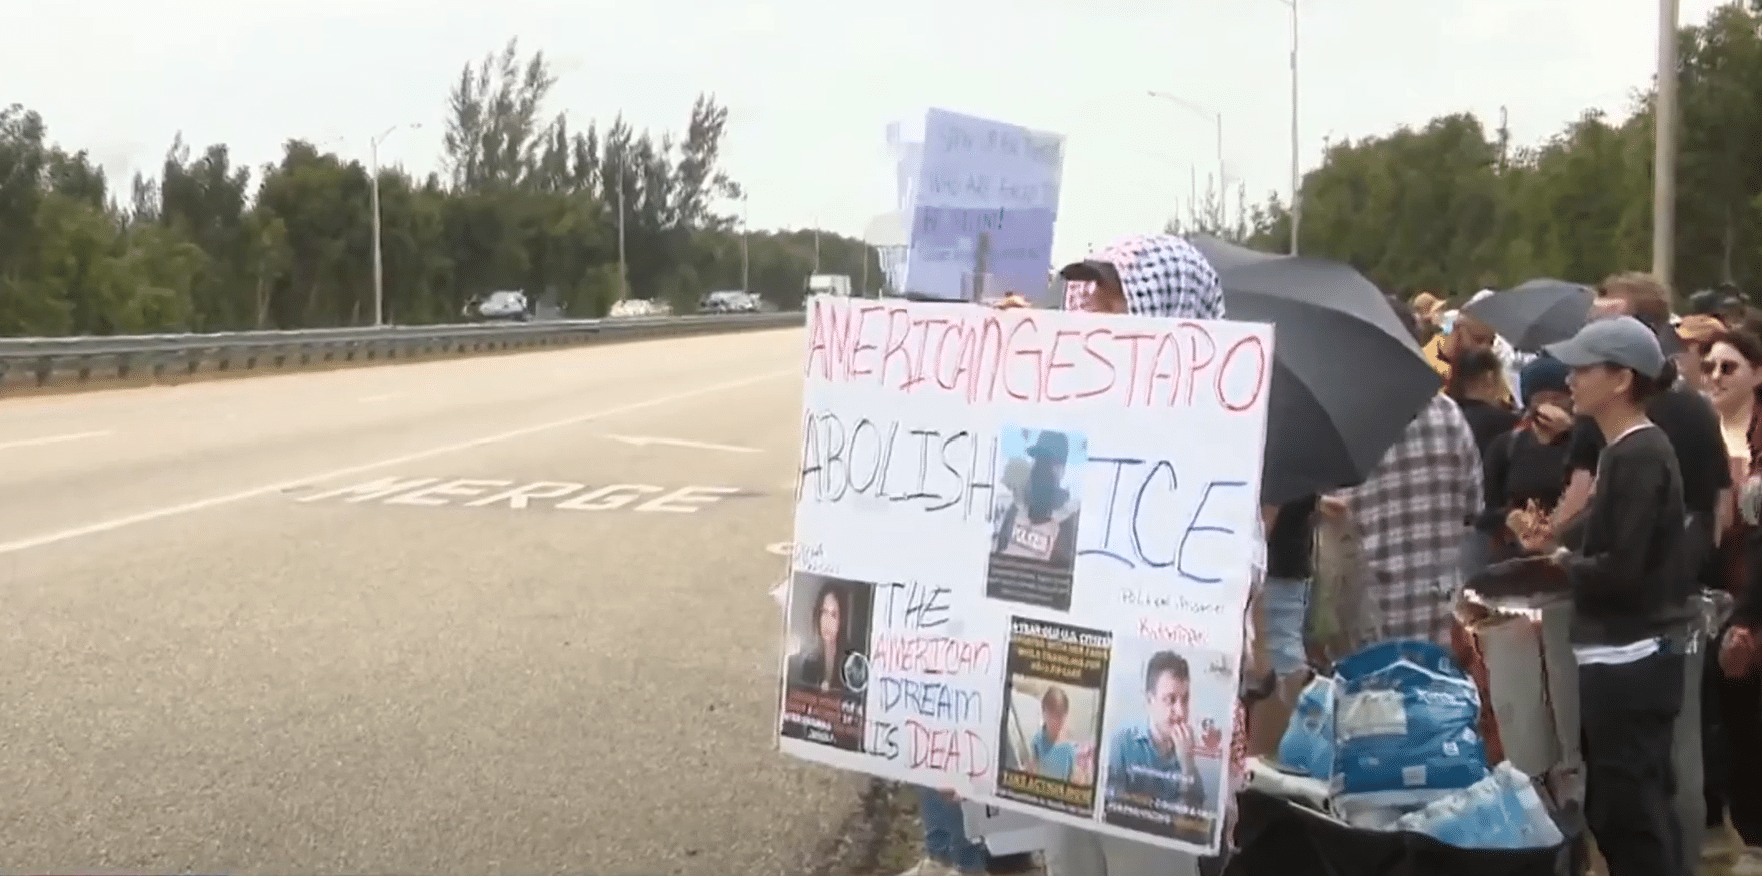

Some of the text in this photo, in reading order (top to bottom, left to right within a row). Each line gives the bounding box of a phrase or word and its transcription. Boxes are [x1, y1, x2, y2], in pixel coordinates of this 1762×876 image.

[1003, 317, 1265, 412] GESTAPO
[299, 476, 741, 514] MERGE
[799, 408, 998, 521] ABOLISH
[1078, 457, 1248, 584] ICE
[876, 581, 952, 629] THE
[878, 676, 982, 724] DREAM
[868, 718, 990, 778] IS DEAD
